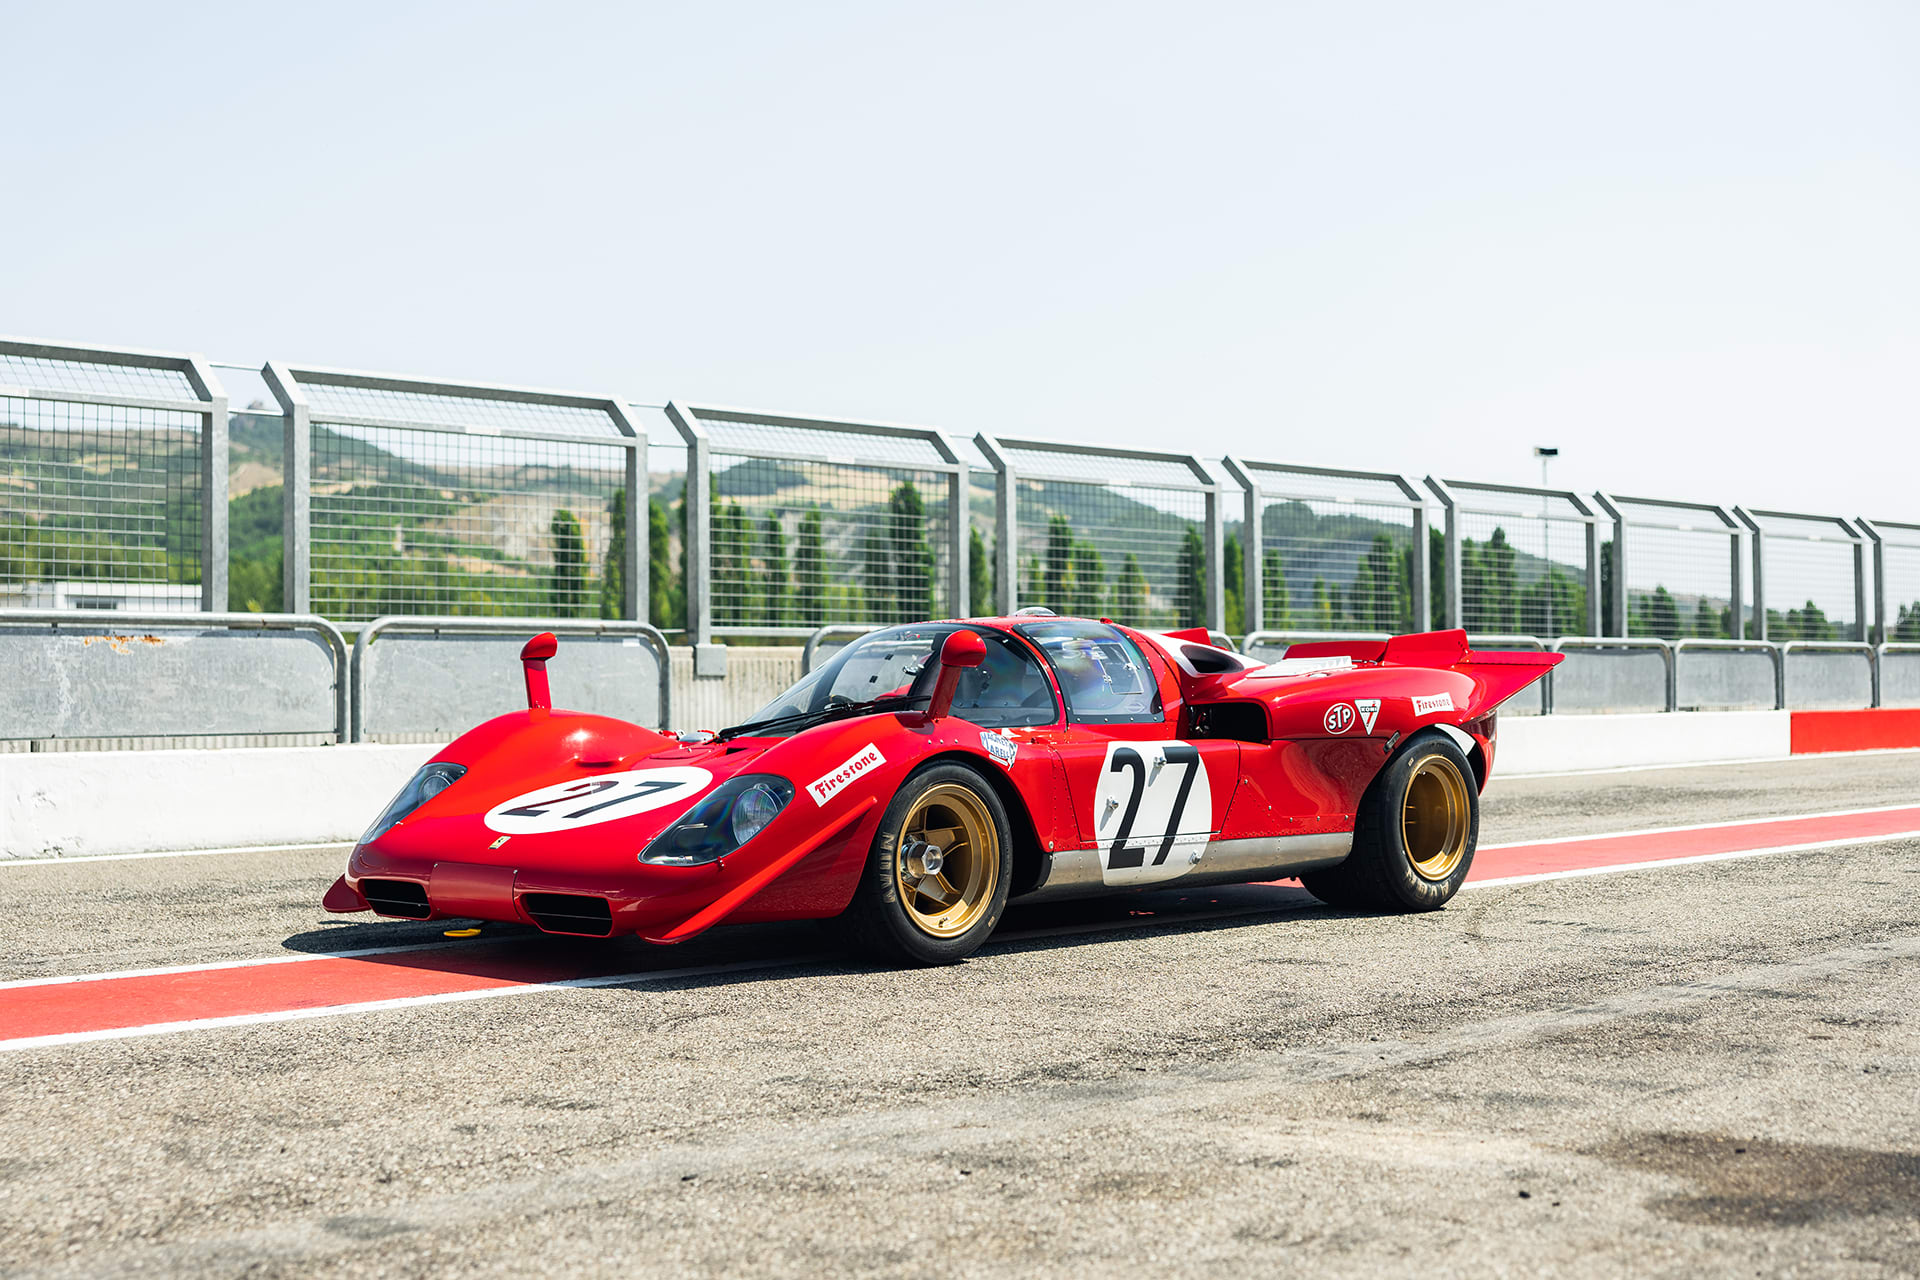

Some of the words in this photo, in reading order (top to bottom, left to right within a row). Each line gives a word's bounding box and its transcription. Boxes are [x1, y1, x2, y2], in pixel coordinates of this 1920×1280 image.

[1328, 705, 1351, 730] STP
[1416, 699, 1450, 713] Firestone
[814, 752, 877, 799] Firestone
[498, 780, 687, 819] 27
[1107, 746, 1200, 869] 27
